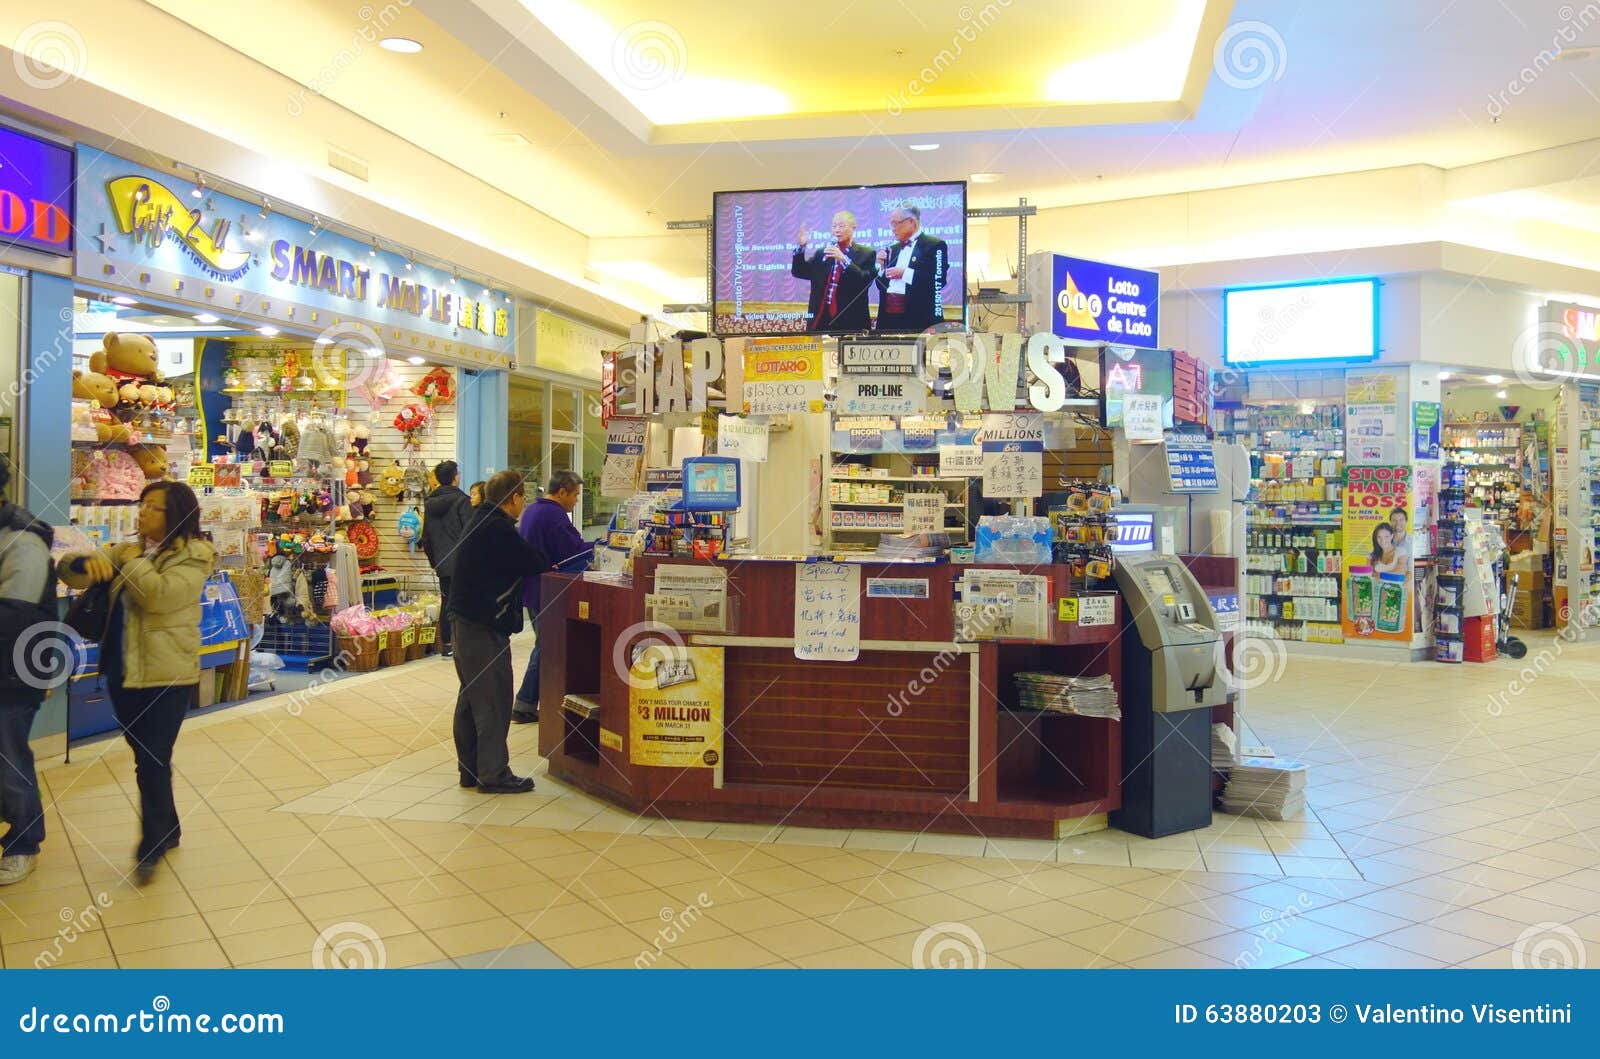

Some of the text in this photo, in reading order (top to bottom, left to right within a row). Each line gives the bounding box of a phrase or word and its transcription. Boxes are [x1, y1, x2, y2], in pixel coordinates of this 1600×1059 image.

[934, 249, 943, 281] Toronto
[271, 239, 369, 302] SMART
[377, 273, 452, 325] MAPLE
[1108, 277, 1140, 297] Lotto
[1060, 293, 1099, 314] OLG
[1107, 297, 1147, 317] Centre
[1107, 316, 1152, 336] de Loto
[757, 360, 808, 373] LOTTARIO
[1003, 414, 1029, 429] 30
[983, 430, 1042, 440] MILLIONS
[1349, 468, 1408, 480] STOP
[1348, 482, 1407, 493] HAIR
[1348, 495, 1408, 508] LOSS
[638, 706, 710, 722] $3 MILLION
